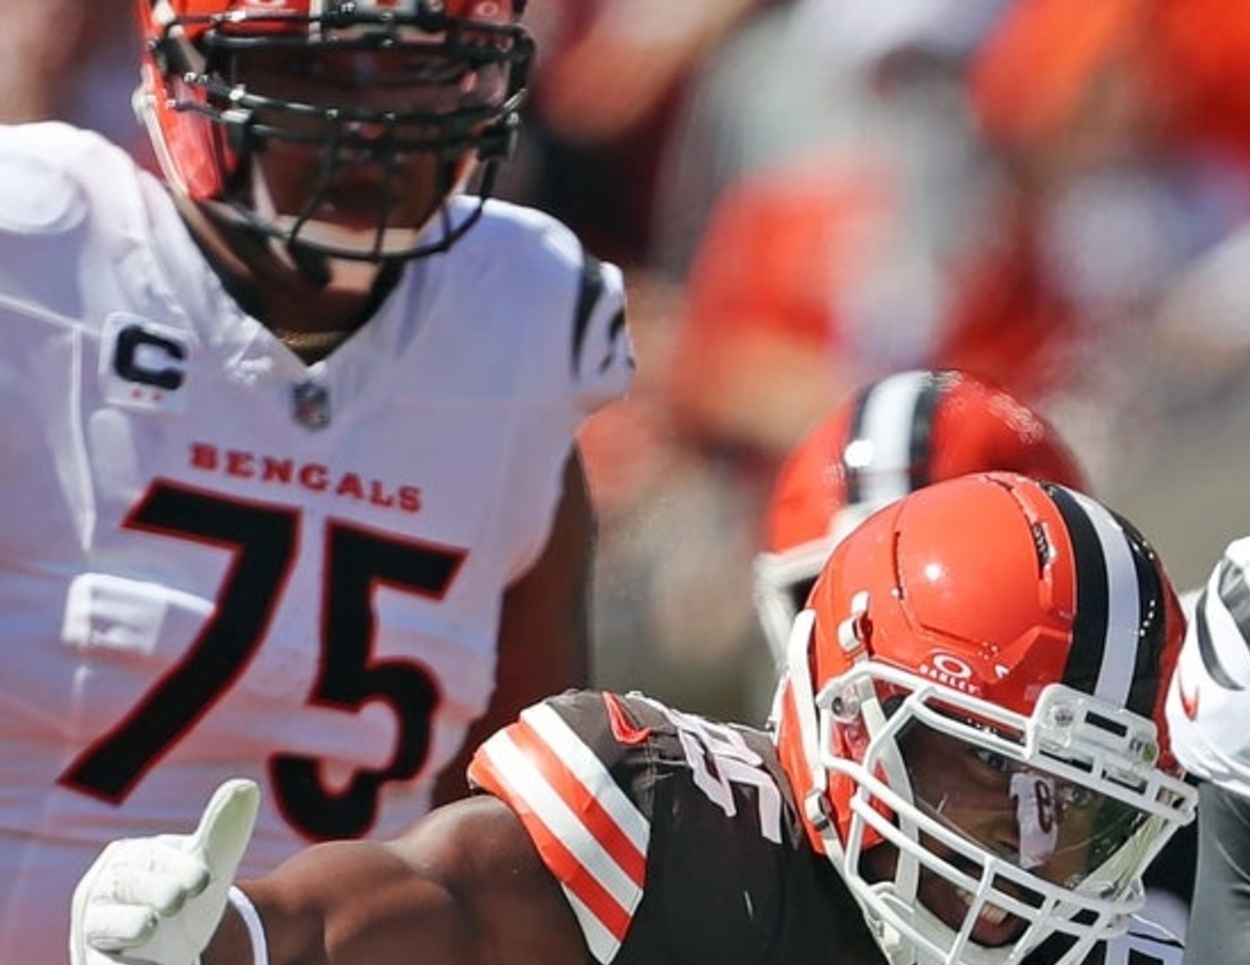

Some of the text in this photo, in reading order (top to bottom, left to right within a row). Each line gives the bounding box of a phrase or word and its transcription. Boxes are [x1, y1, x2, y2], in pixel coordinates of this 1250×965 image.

[114, 324, 188, 391] C
[190, 441, 424, 513] BENGALS
[56, 477, 470, 844] 75
